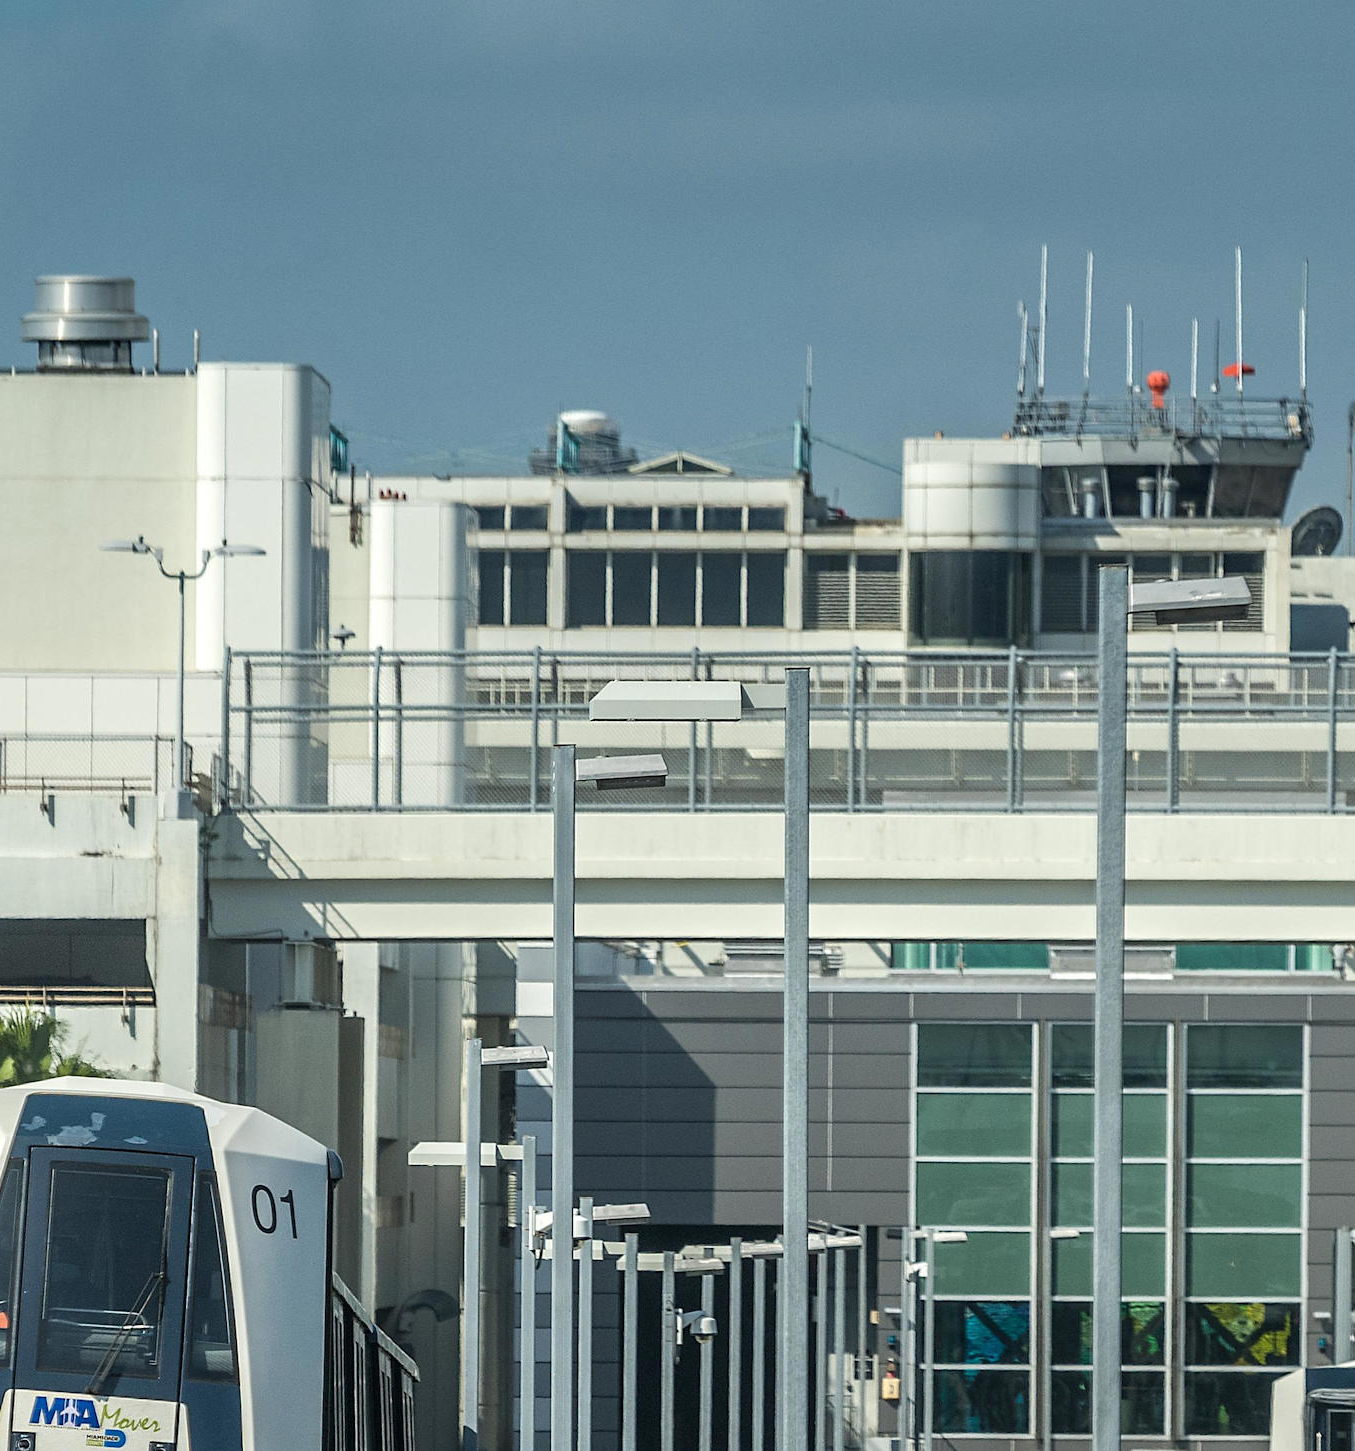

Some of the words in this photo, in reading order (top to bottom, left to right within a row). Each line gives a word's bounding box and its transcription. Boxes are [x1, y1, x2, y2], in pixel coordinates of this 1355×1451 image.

[251, 1184, 298, 1240] 01
[28, 1396, 101, 1429] MIA
[100, 1403, 161, 1433] Mover
